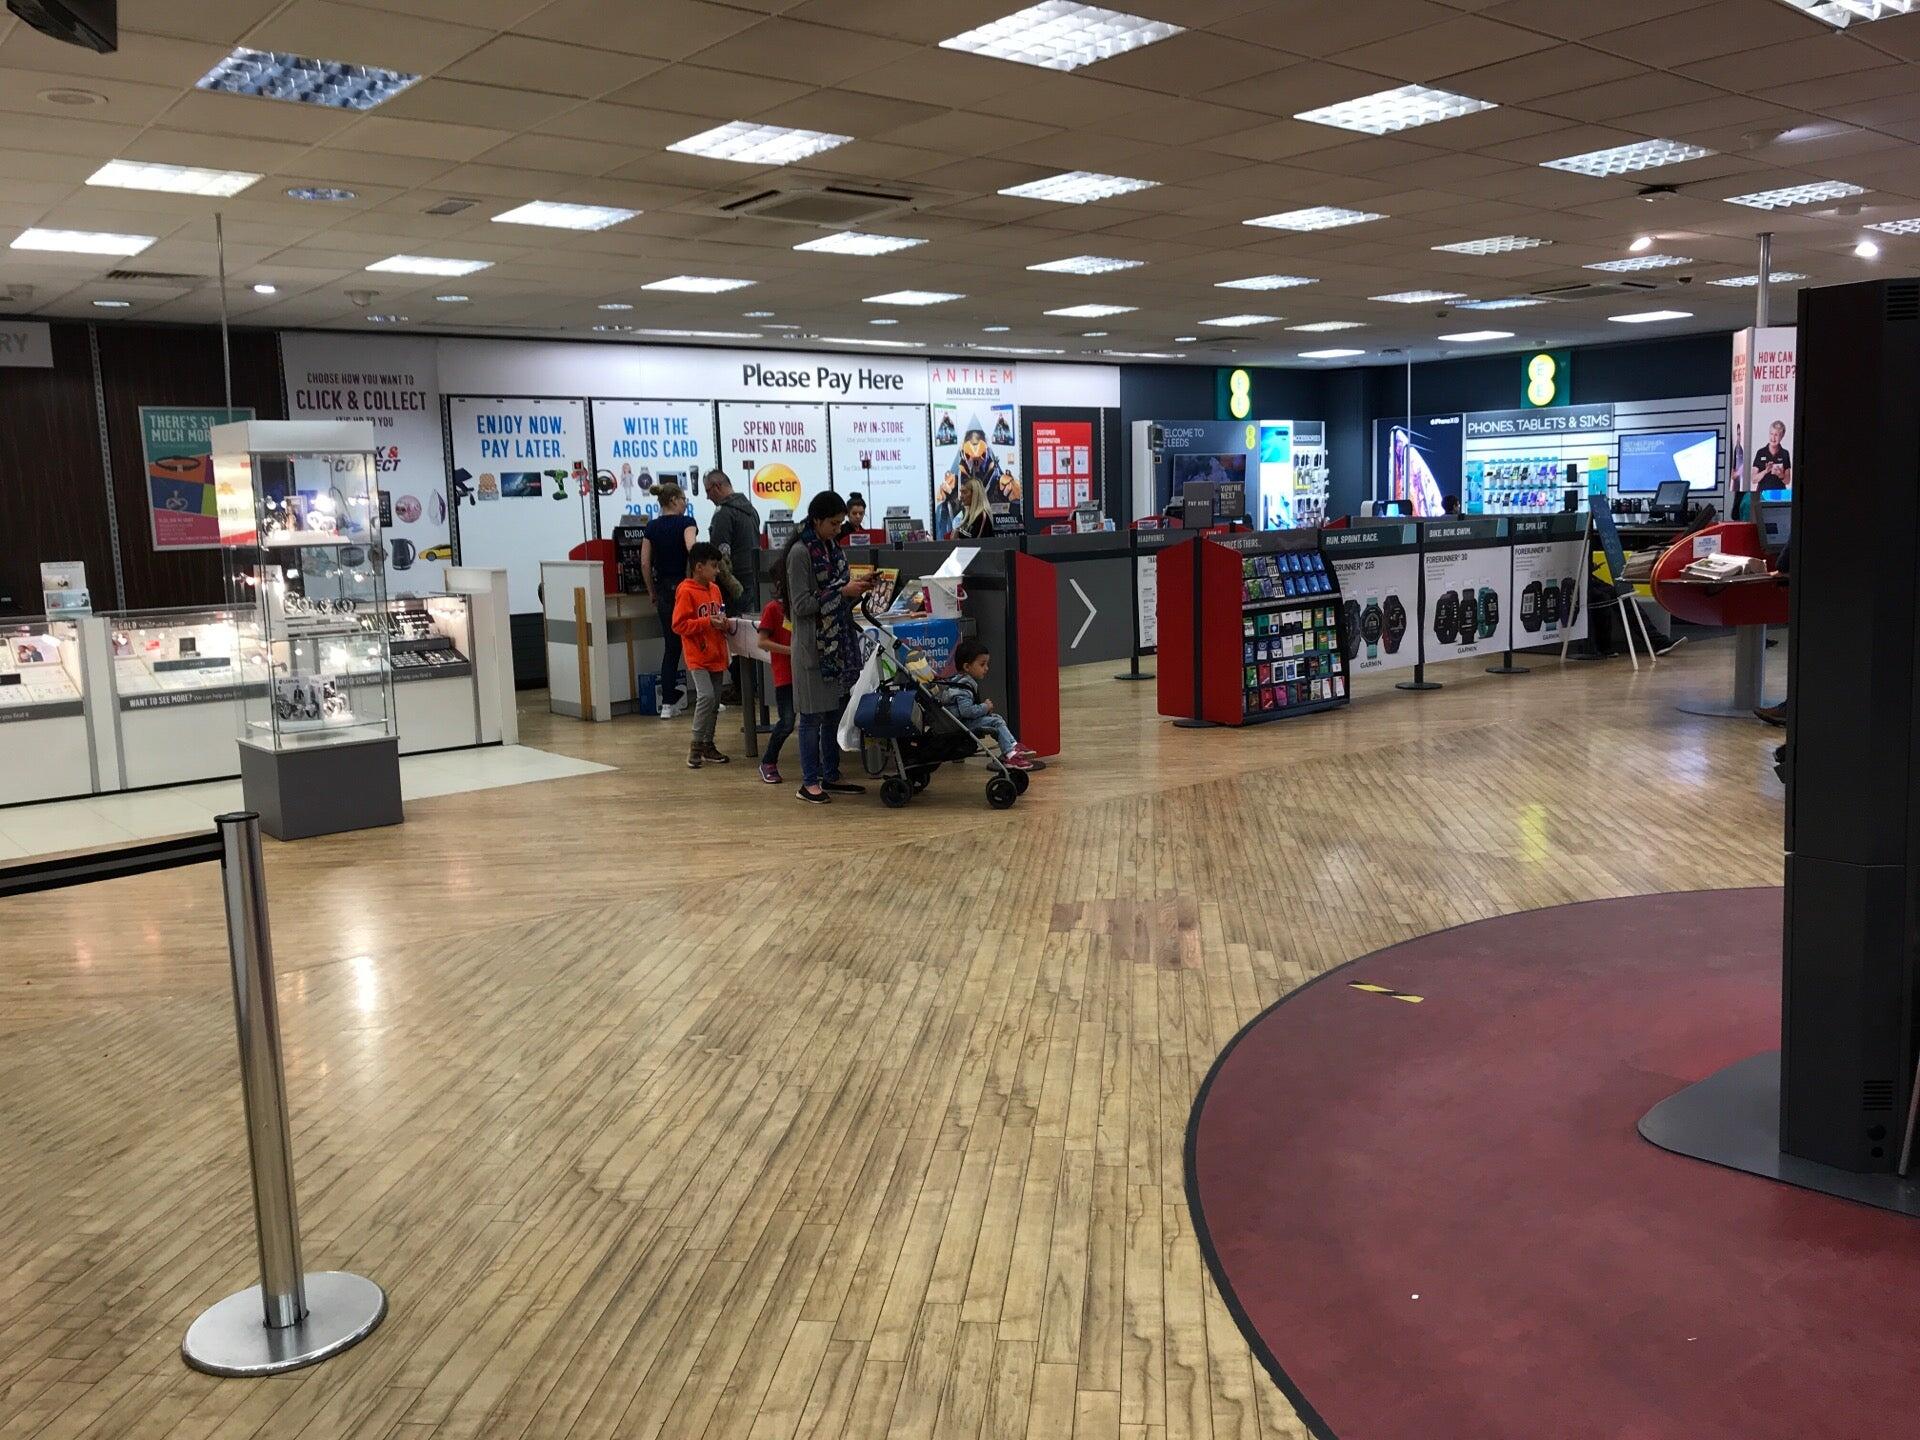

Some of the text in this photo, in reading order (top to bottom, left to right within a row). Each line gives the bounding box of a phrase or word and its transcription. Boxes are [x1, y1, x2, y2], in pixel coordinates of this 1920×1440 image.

[1758, 351, 1794, 363] HOW CAN
[307, 372, 415, 386] CHOOSE HOW YOU WANT TO
[742, 363, 904, 395] Please Pay Here
[932, 367, 1014, 384] ANTHEM
[1753, 364, 1796, 380] WE HELP?
[946, 386, 977, 397] AVAILABLE
[1762, 384, 1788, 393] JUST ASK
[296, 389, 427, 411] CLICK & COLLECT
[1773, 395, 1789, 403] TEAM
[150, 414, 216, 430] THERE'S SO
[376, 416, 393, 427] YOU
[477, 414, 567, 435] ENJOY NOW.
[623, 417, 689, 435] WITH THE
[743, 421, 805, 436] SPEND YOUR
[853, 421, 904, 434] PAY IN-STORE
[1467, 414, 1611, 435] PHONES, TABLETS & SIMS
[152, 429, 185, 442] MUCH
[1163, 428, 1205, 439] ELCOME TO
[481, 439, 566, 459] PAY LATER.
[613, 440, 698, 458] ARGOS CARD
[732, 438, 817, 453] POINTS AT ARGOS
[1168, 438, 1190, 448] LEEDS
[388, 445, 399, 459] &
[859, 449, 902, 461] PAY ONLINE
[756, 479, 798, 493] nectar
[1220, 492, 1235, 500] NEXT
[995, 516, 1019, 524] DURACELL
[906, 635, 949, 648] Taking on
[129, 694, 193, 709] WANT TO SEE MORE?
